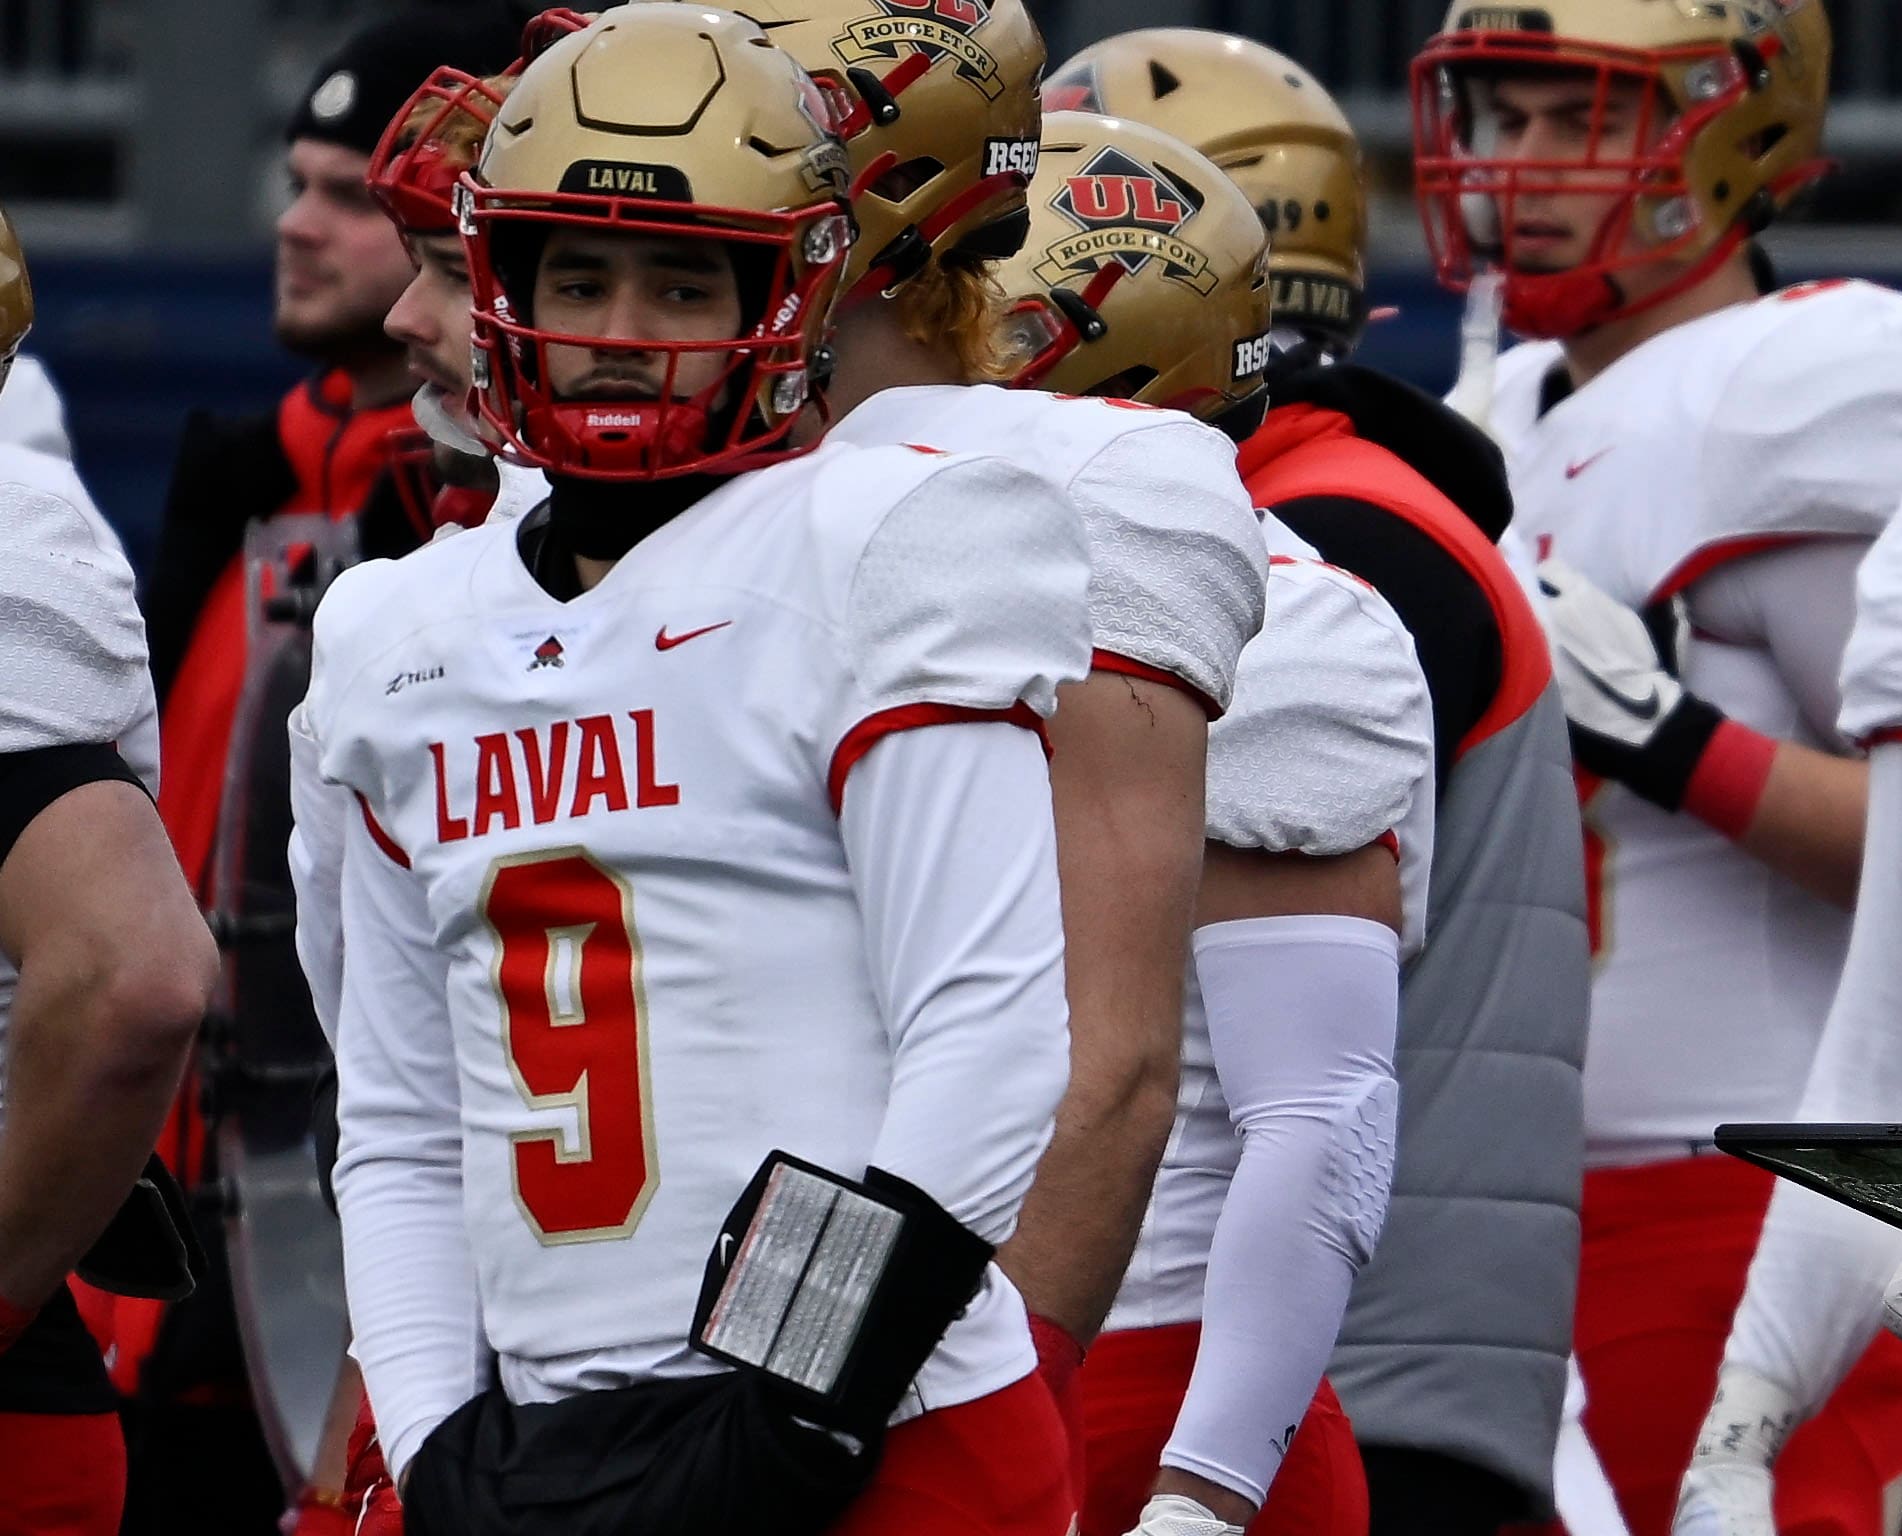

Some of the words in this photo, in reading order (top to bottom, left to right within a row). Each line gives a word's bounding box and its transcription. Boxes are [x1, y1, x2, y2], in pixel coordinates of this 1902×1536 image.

[861, 22, 935, 41] ROUGE
[938, 29, 963, 47] ET
[966, 45, 989, 71] OR
[587, 166, 659, 193] LAVAL
[1065, 174, 1183, 224] UL
[1062, 231, 1137, 261] ROUGE
[1170, 243, 1197, 268] OR
[429, 708, 680, 843] LAVAL
[475, 843, 661, 1247] 9
